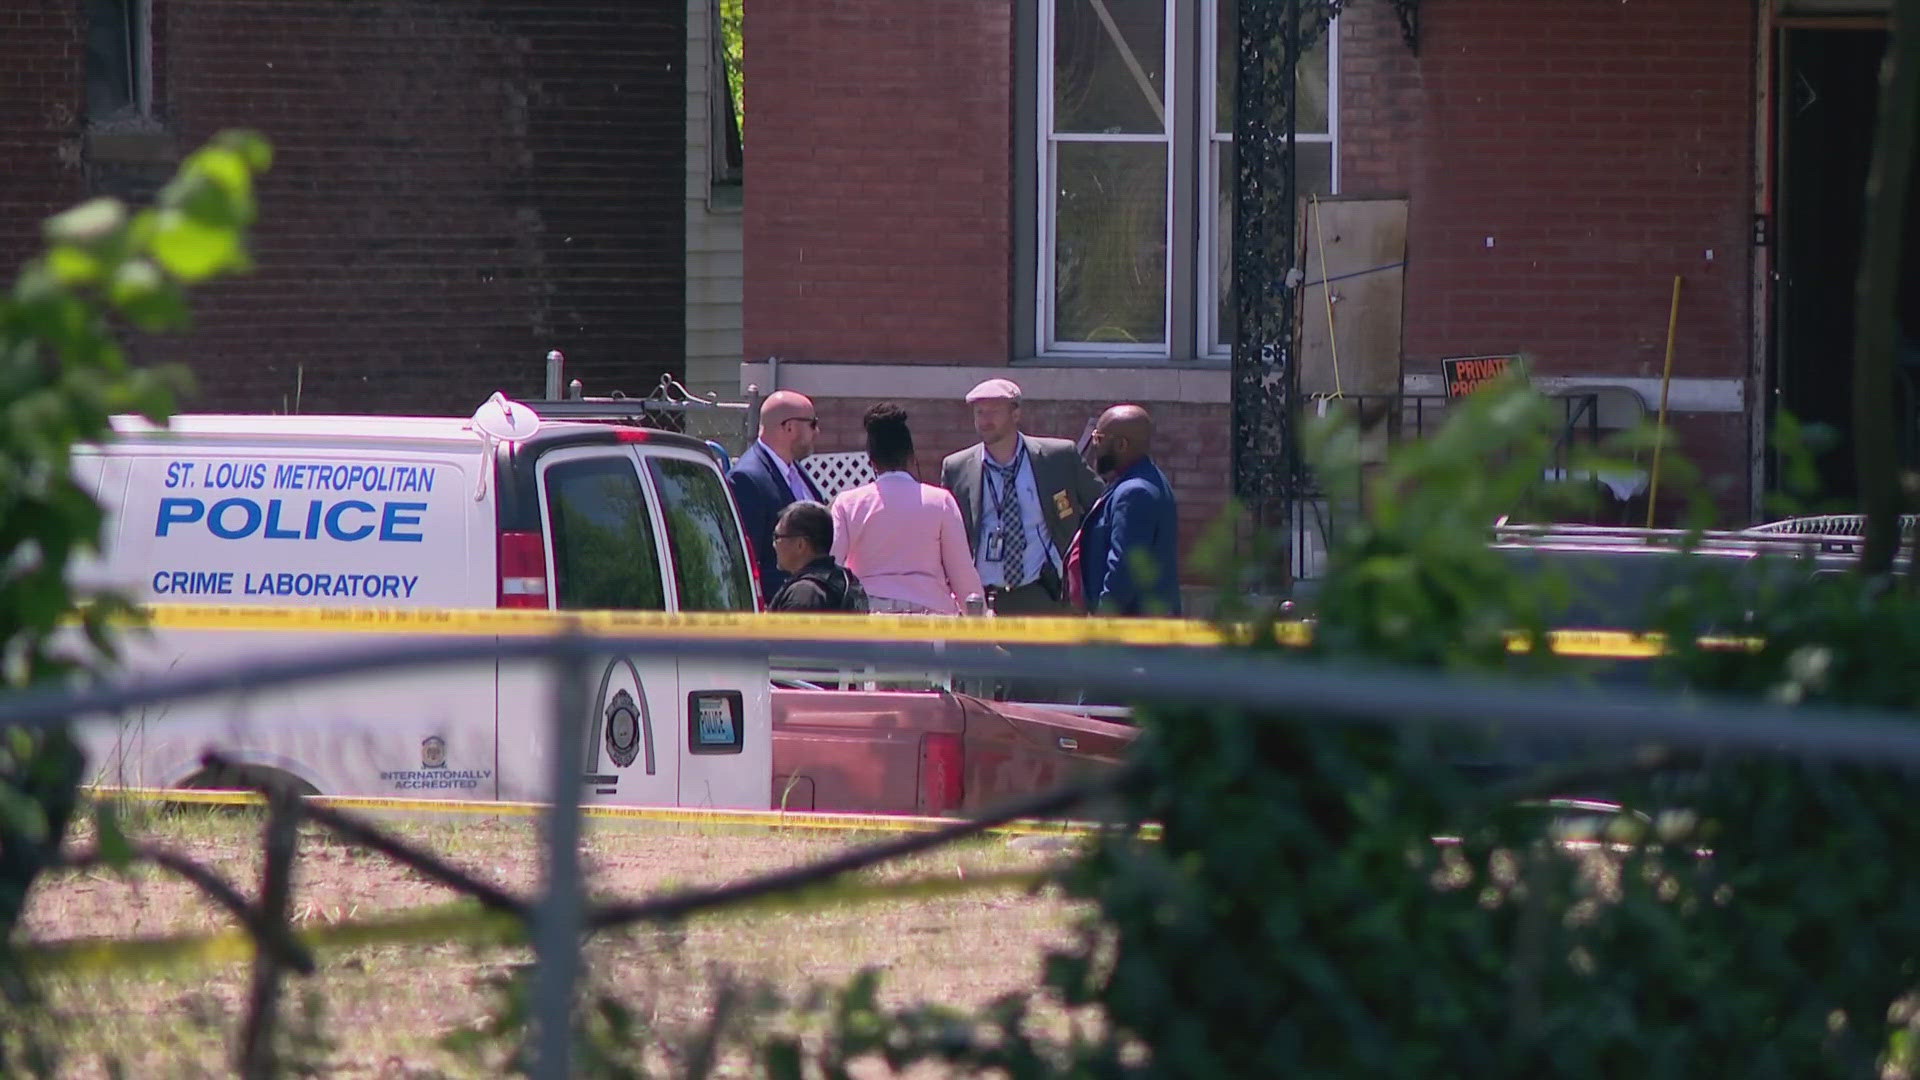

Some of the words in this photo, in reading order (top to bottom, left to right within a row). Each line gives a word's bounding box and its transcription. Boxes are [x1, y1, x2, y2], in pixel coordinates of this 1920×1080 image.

[165, 461, 194, 488] ST.
[204, 463, 267, 490] LOUIS
[273, 464, 435, 493] METROPOLITAN
[155, 497, 428, 542] POLICE
[153, 570, 234, 595] CRIME
[244, 572, 418, 598] LABORATORY
[381, 769, 491, 781] INTERNATIONALLY
[394, 780, 477, 790] ACCREDITED
